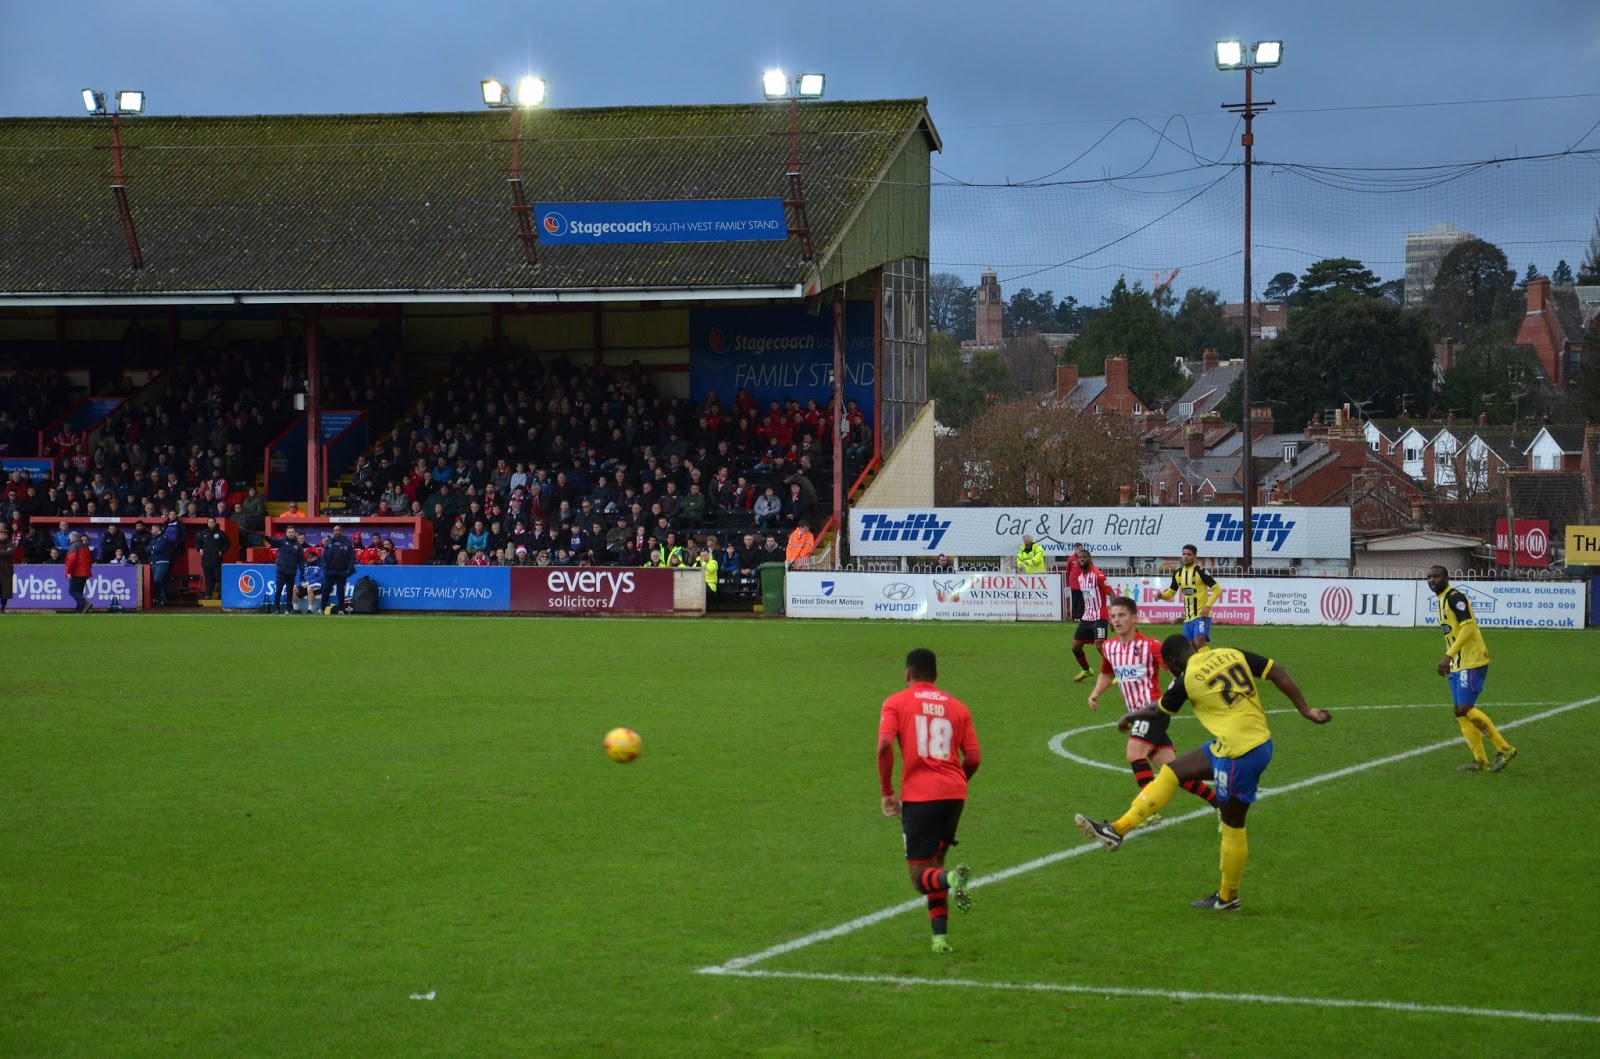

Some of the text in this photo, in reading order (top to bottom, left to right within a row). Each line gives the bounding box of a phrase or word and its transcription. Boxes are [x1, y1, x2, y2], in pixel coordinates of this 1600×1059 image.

[570, 220, 779, 236] Stagecoach SOUTH WEST FAMILY STAND
[734, 335, 814, 354] Stagecoach
[735, 362, 874, 387] FAMILY STND
[860, 514, 952, 550] Thrifty
[996, 513, 1032, 536] Car
[1036, 513, 1050, 535] &
[1060, 514, 1094, 536] Van
[1104, 514, 1164, 536] Rental
[1498, 534, 1524, 550] MASH
[12, 574, 62, 598] lybe.
[548, 571, 636, 608] everys
[970, 576, 1048, 590] PHOENIX
[394, 587, 421, 598] WEST
[424, 588, 458, 598] FAMILY
[460, 588, 492, 598] STAND
[970, 590, 1048, 600] WINDSCREENS
[548, 596, 608, 608] solicitors
[1355, 594, 1401, 616] JLL
[1096, 627, 1106, 636] 31
[1205, 662, 1256, 710] 29
[922, 702, 945, 716] REID
[1132, 720, 1150, 735] 20
[914, 715, 953, 760] 18
